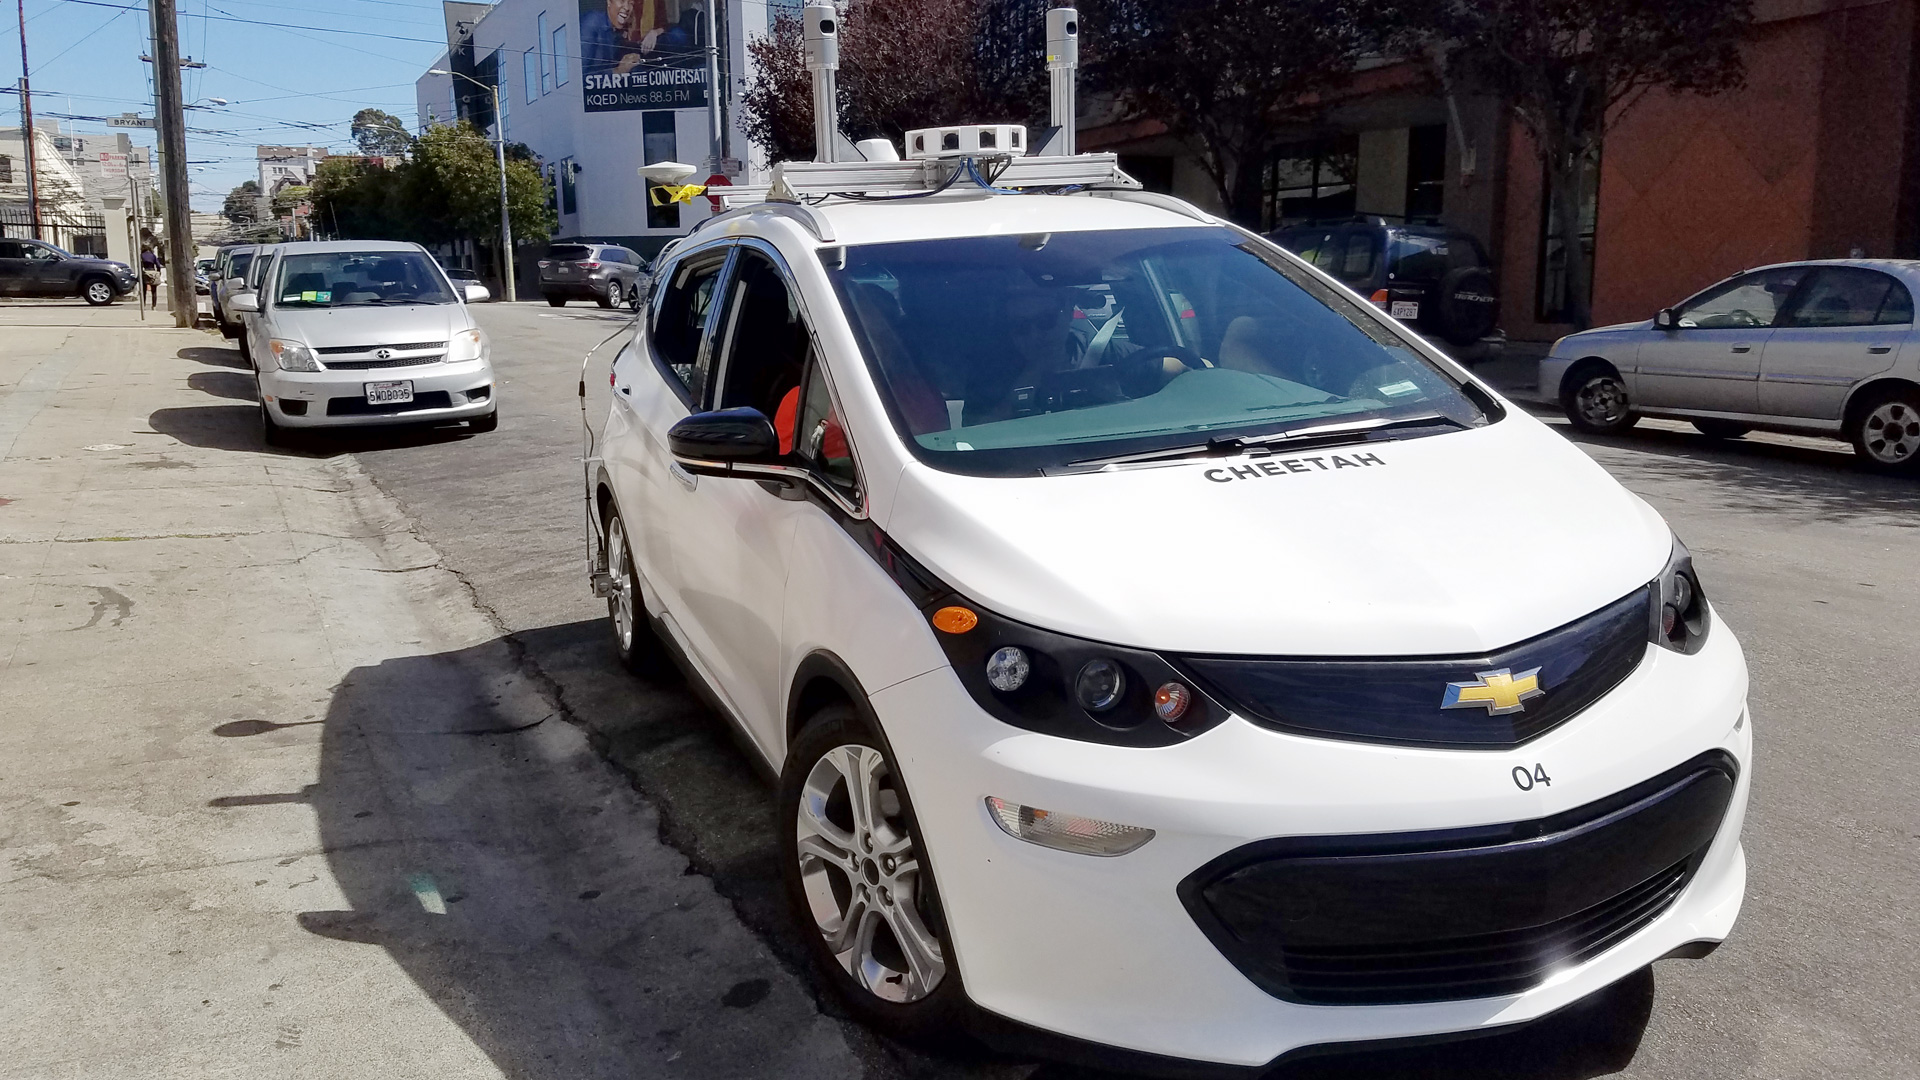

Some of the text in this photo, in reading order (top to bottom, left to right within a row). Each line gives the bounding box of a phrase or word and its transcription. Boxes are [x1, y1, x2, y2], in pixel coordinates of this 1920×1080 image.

[585, 68, 720, 90] START THE CONVERSATI
[586, 94, 617, 107] KQED
[620, 93, 647, 104] News
[649, 90, 672, 103] 88.5
[674, 90, 690, 102] FM
[1203, 452, 1387, 483] CHEETAH
[1511, 763, 1552, 792] 04
